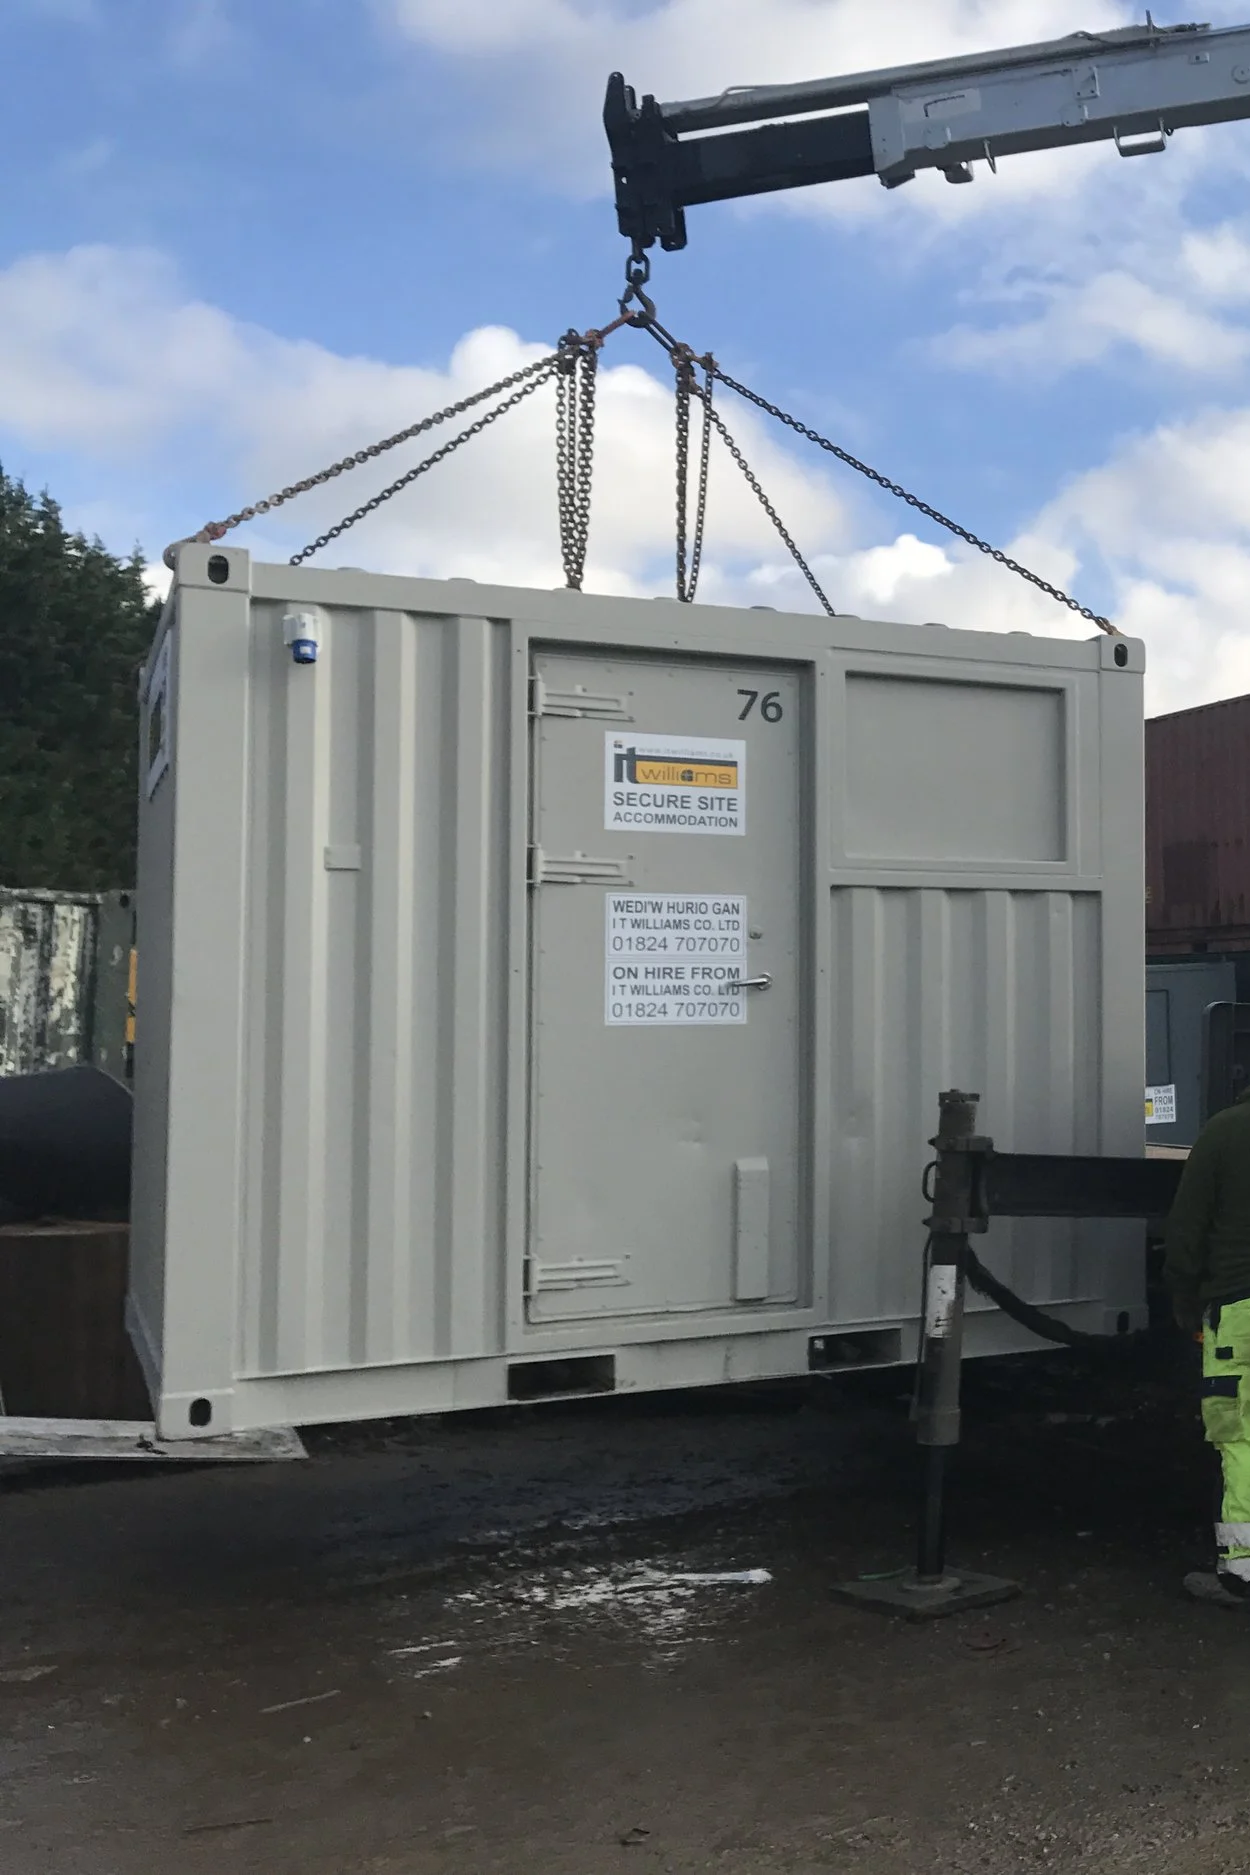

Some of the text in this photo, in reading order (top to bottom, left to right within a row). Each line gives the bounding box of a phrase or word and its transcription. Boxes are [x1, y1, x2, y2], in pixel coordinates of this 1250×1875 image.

[736, 689, 783, 723] 76
[613, 740, 732, 785] it williams
[613, 791, 738, 812] SECURE SITE
[613, 811, 738, 828] ACCOMMODATION
[613, 900, 740, 916] WEDI'W HURIO GAN
[619, 918, 627, 929] T
[630, 919, 690, 931] WILLIAMS
[694, 919, 715, 931] CO.
[718, 920, 740, 931] LTD
[612, 936, 740, 952] 01824 707070
[612, 967, 740, 980] ON HIRE FROM
[619, 985, 626, 996] T
[630, 984, 690, 996] WILLIAMS
[693, 984, 714, 996] CO.
[612, 1003, 740, 1017] 01824 707070
[1154, 1095, 1173, 1105] FROM
